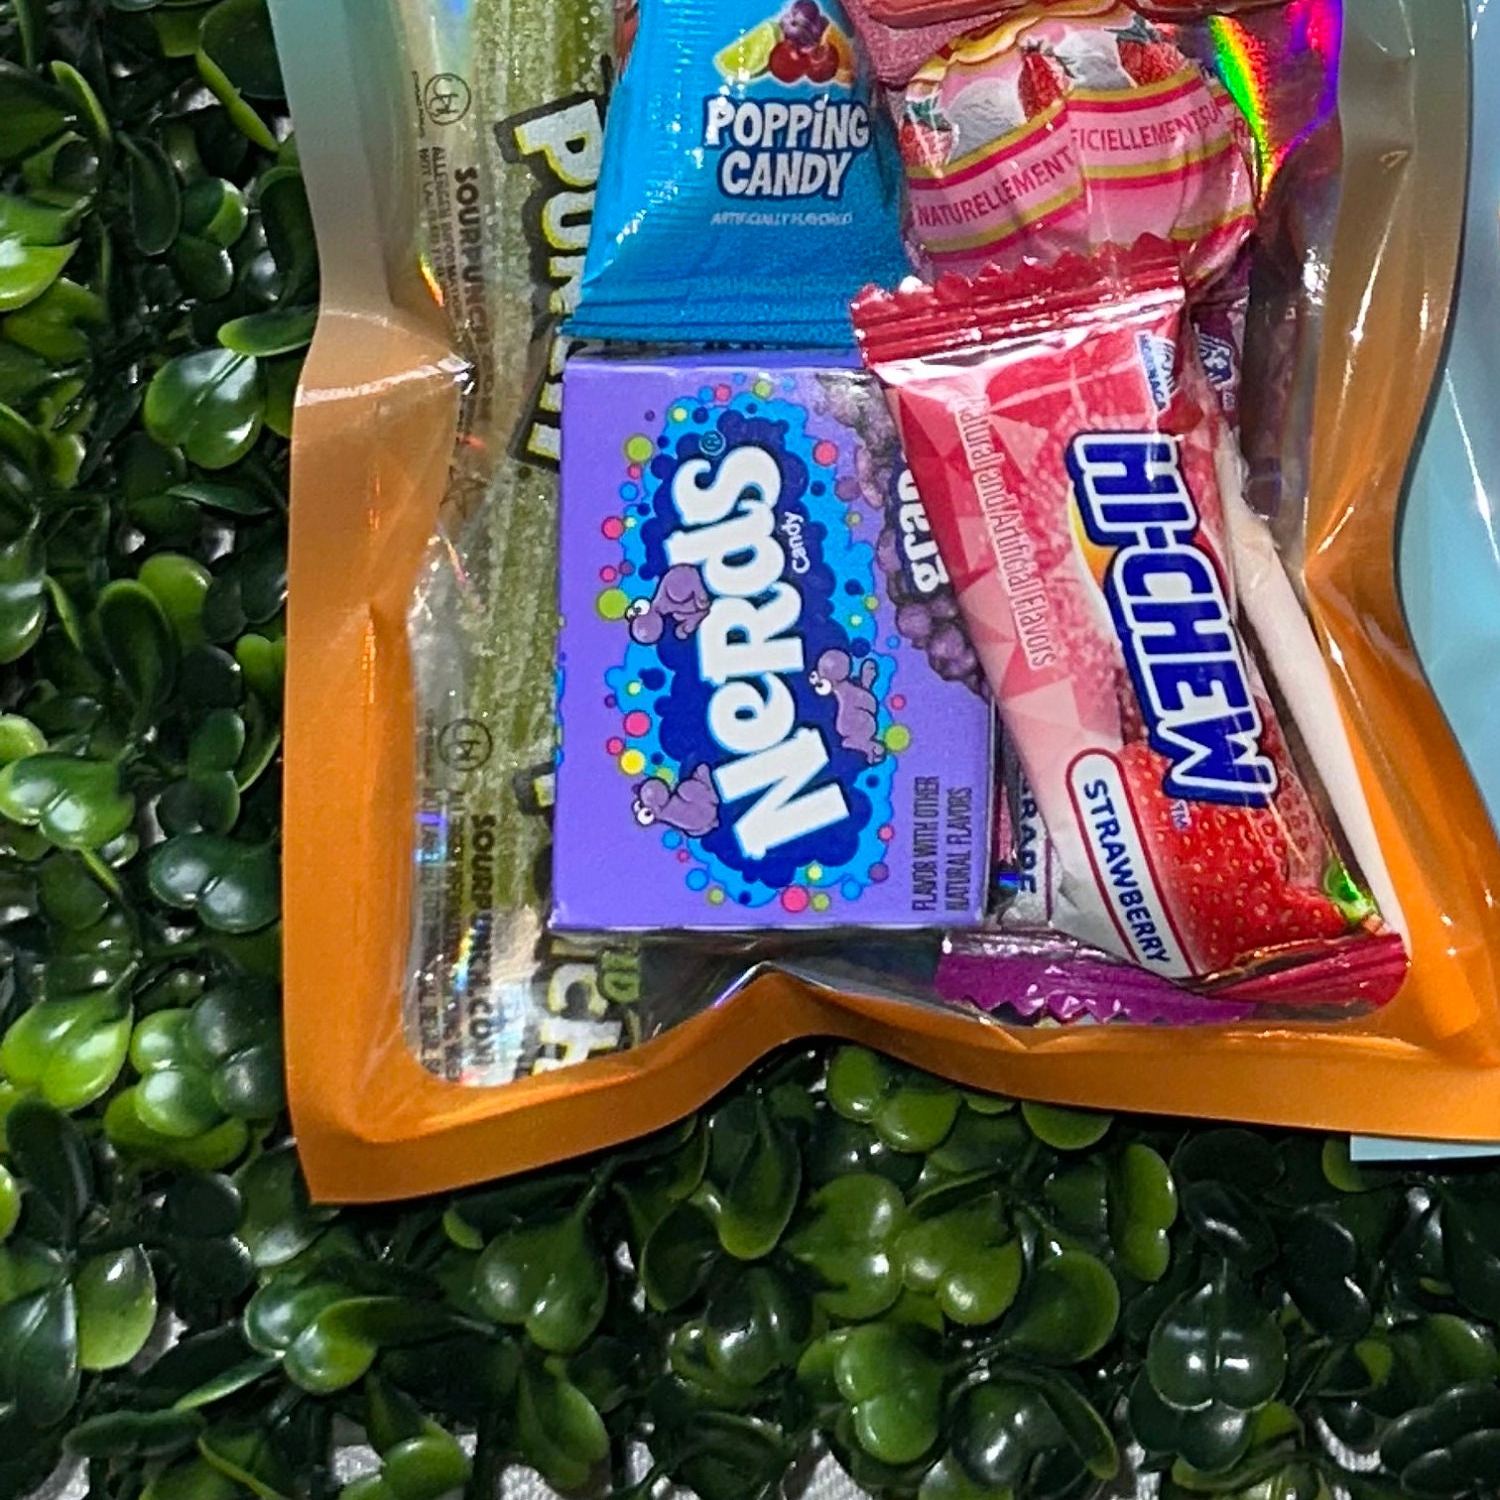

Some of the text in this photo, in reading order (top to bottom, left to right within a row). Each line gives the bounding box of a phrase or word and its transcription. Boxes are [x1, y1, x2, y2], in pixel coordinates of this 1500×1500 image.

[722, 151, 848, 197] CANDY
[917, 143, 1072, 227] NATURELLEMENT
[1013, 588, 1056, 671] Flavors
[1066, 432, 1277, 808] HI-CHEW
[914, 776, 940, 819] OTHER
[947, 786, 973, 845] FLAVORS
[912, 861, 937, 911] FLAVOR
[1084, 778, 1173, 965] STRAWBERRY
